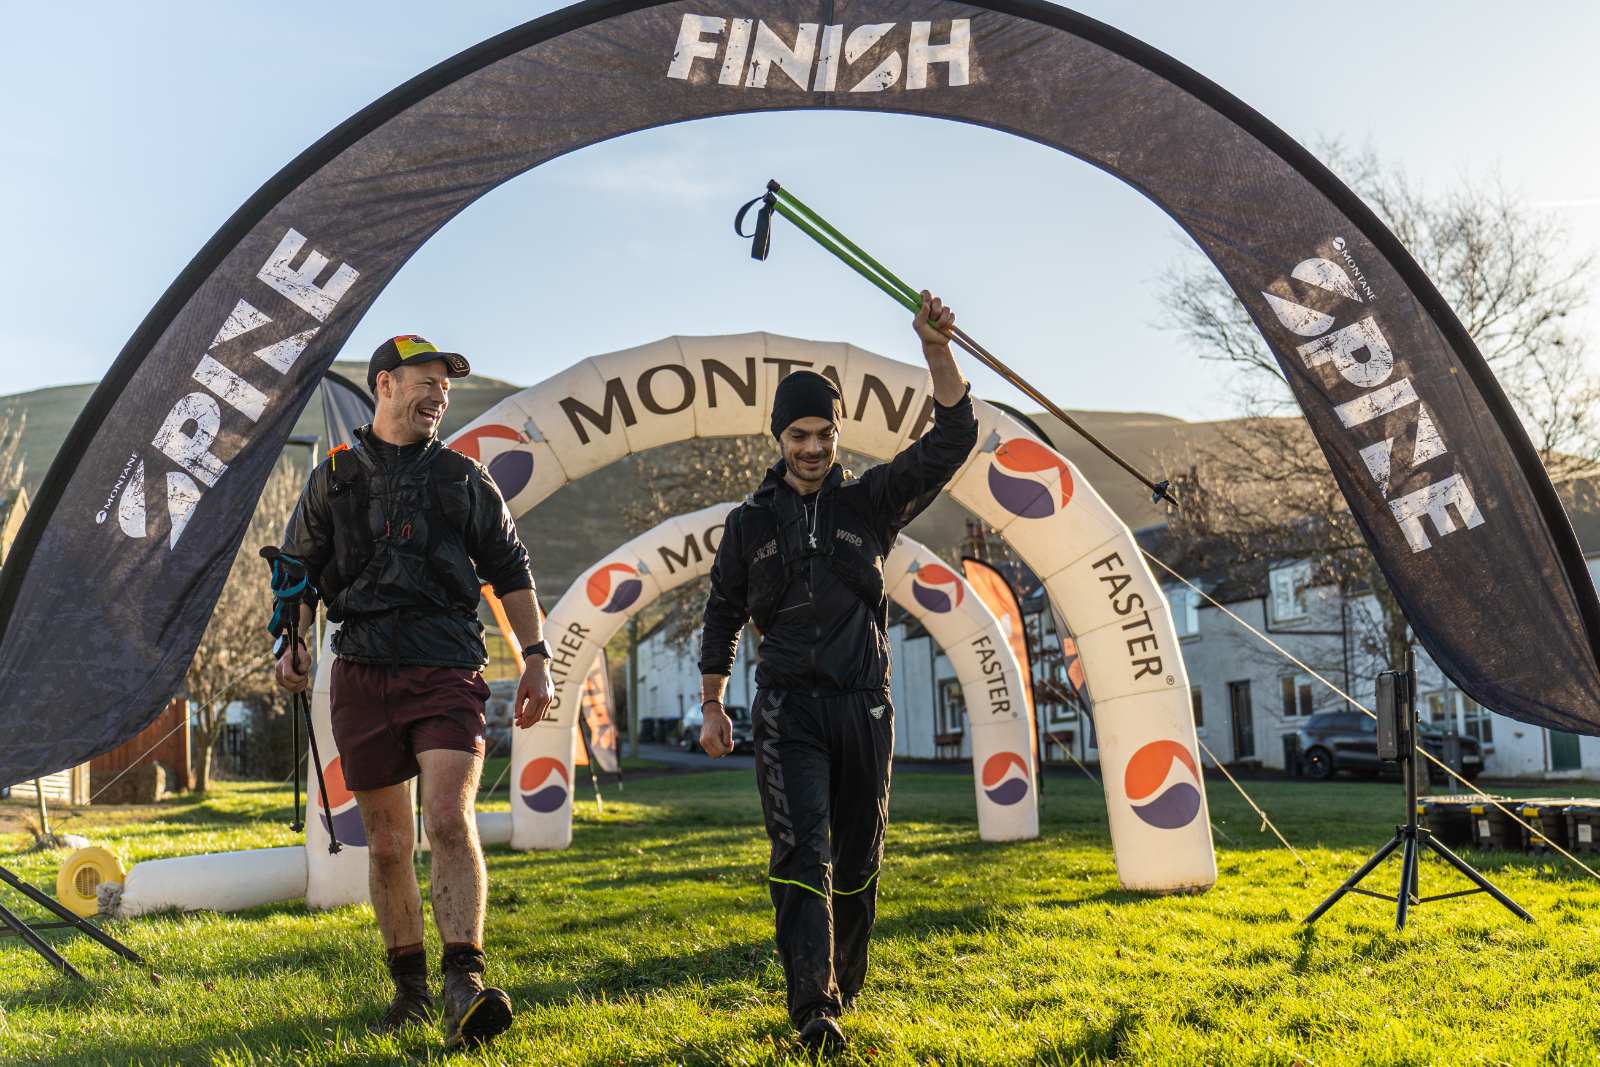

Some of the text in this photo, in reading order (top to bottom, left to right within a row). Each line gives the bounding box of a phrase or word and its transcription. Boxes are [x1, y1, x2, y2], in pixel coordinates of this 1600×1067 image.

[667, 13, 970, 92] FINISH
[1341, 249, 1377, 302] MONTANE
[118, 228, 360, 551] SPINE
[1261, 258, 1485, 553] SPINE
[836, 528, 863, 547] wise
[1092, 552, 1163, 681] FASTER
[971, 636, 1011, 715] FASTER
